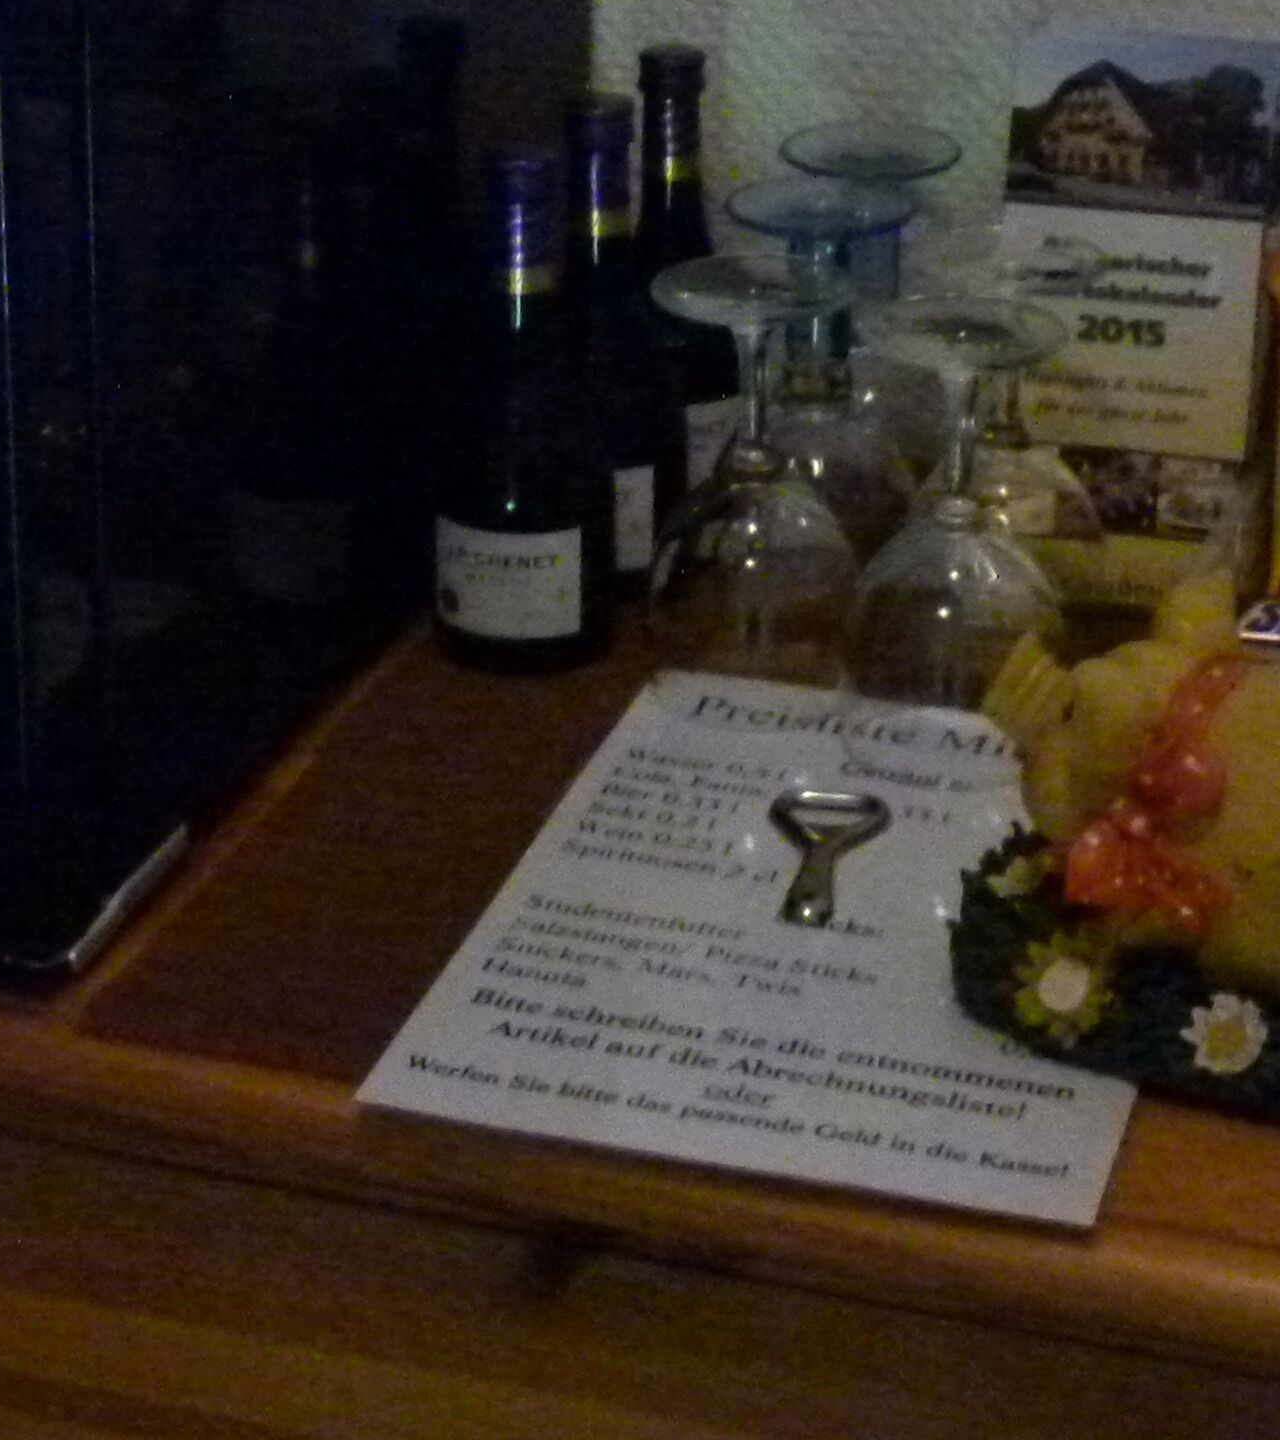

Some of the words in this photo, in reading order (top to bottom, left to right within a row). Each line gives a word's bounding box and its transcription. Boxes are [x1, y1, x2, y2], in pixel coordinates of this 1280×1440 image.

[1076, 313, 1167, 347] 2015
[688, 694, 922, 746] Preisliste
[470, 987, 545, 1015] Bitte
[551, 1006, 706, 1041] schreiben
[715, 1025, 769, 1050] Sie
[776, 1037, 827, 1062] die
[835, 1050, 1077, 1102] entnommenen
[487, 1018, 600, 1052] Artikel
[603, 1040, 663, 1062] auf
[668, 1047, 720, 1072] die
[407, 1053, 502, 1086] Werfen
[507, 1072, 553, 1096] Sie
[557, 1080, 621, 1107] bitte
[625, 1091, 673, 1115] das
[677, 1103, 807, 1137] passende
[812, 1118, 883, 1149] Geld
[889, 1132, 917, 1157] in
[925, 1140, 970, 1166] die
[703, 1082, 778, 1110] oder
